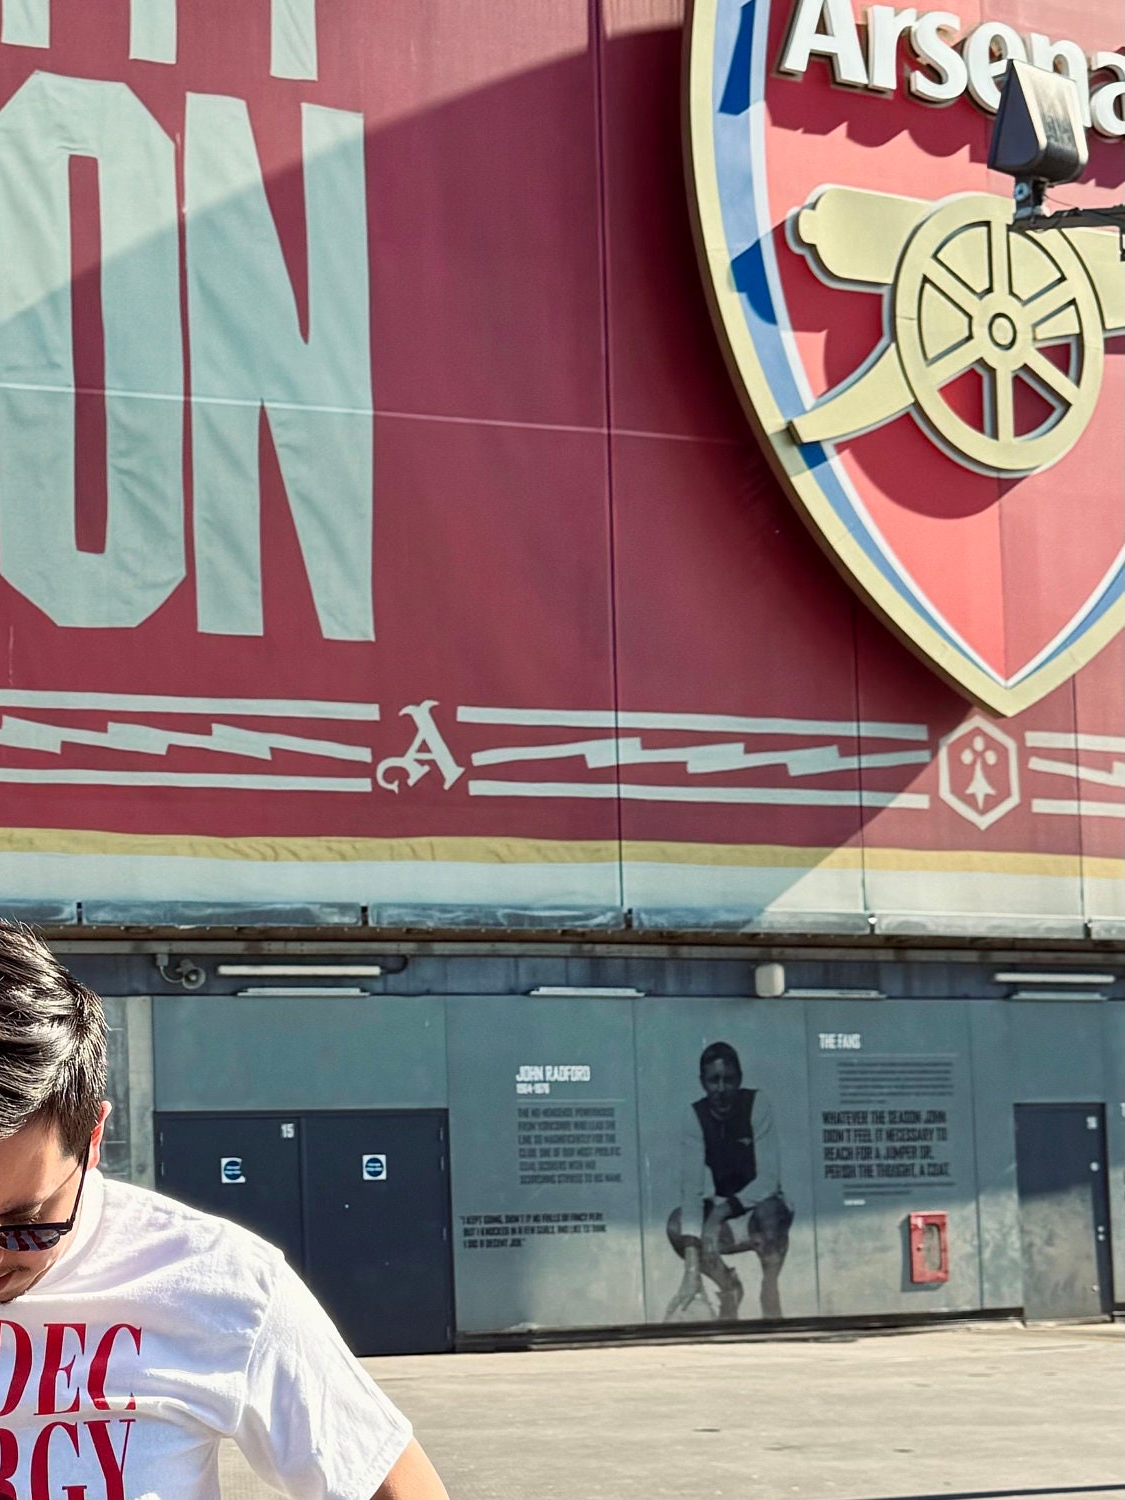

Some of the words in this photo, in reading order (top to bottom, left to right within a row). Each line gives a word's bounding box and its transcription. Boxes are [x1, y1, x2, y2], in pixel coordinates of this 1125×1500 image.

[819, 1033, 838, 1049] THE
[516, 1066, 543, 1081] JOHN
[545, 1066, 591, 1081] RADFORD
[822, 1110, 868, 1125] WHATEVER
[871, 1110, 885, 1125] THE
[280, 1123, 295, 1138] 15
